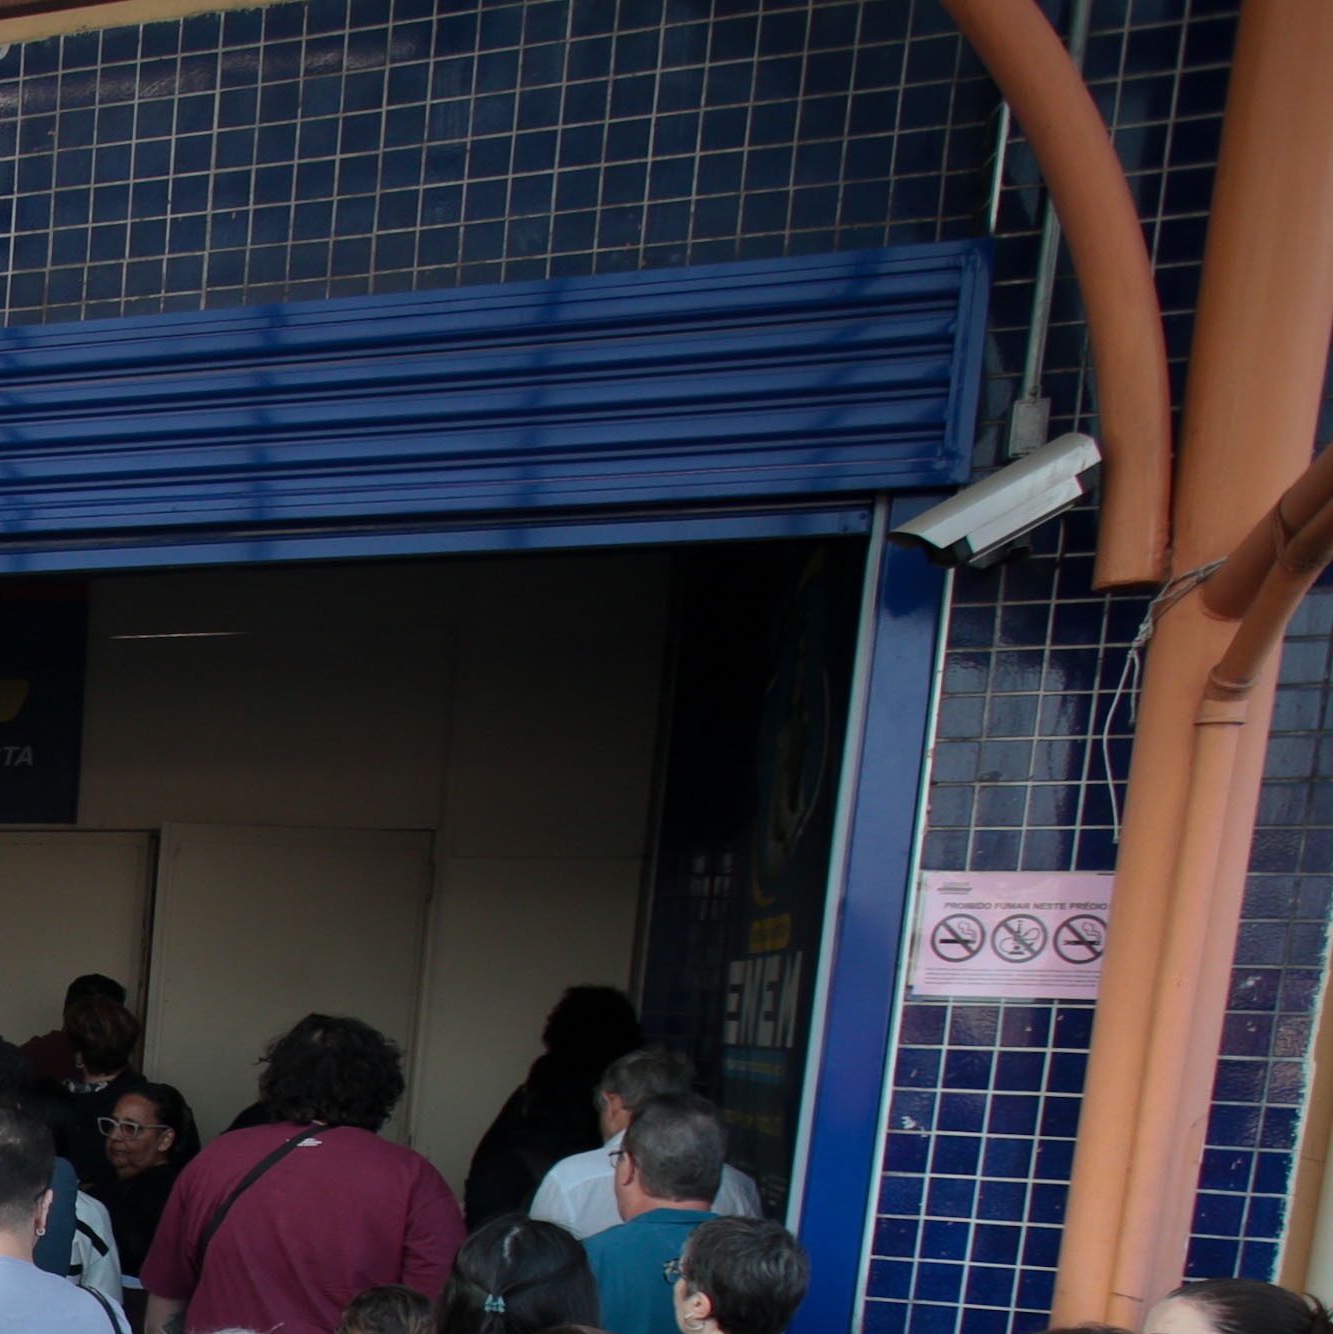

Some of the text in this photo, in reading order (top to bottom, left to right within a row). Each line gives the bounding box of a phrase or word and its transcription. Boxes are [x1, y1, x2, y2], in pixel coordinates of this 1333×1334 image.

[944, 901, 1109, 910] PROIBIDO FUMAR NESTE PRÉDIO
[725, 951, 804, 1048] ENEM
